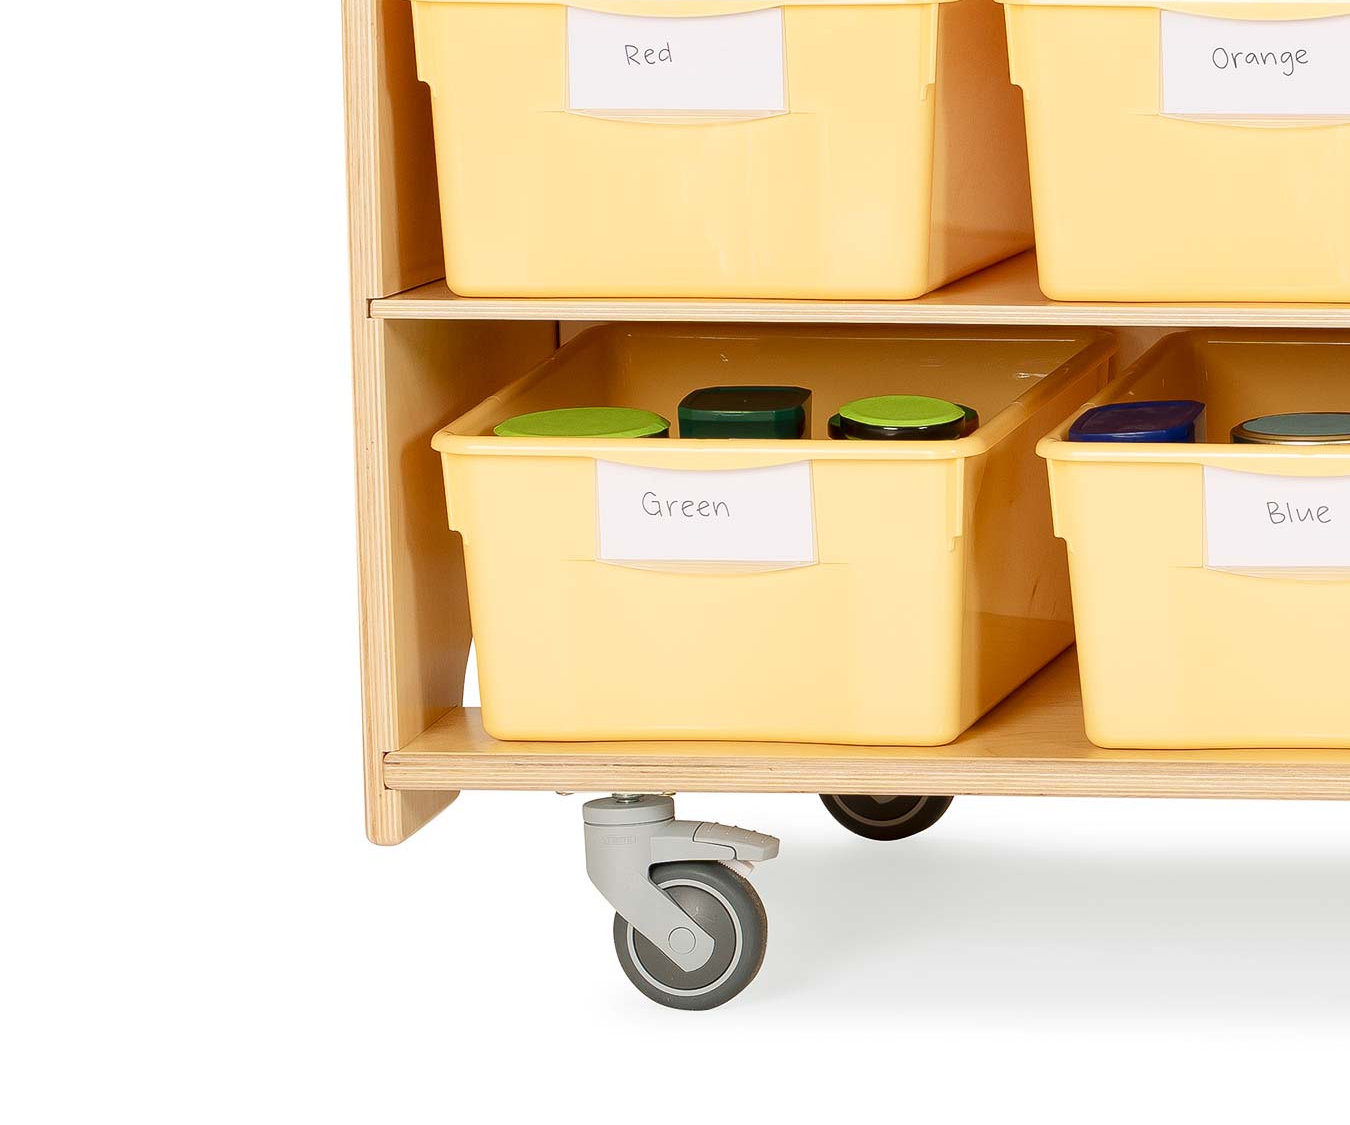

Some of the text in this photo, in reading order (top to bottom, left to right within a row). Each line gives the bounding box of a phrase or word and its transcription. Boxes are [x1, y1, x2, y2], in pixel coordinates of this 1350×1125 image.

[624, 41, 673, 66] Red
[1211, 47, 1309, 76] Orange
[641, 491, 731, 518] Green
[1266, 501, 1332, 525] Blue
